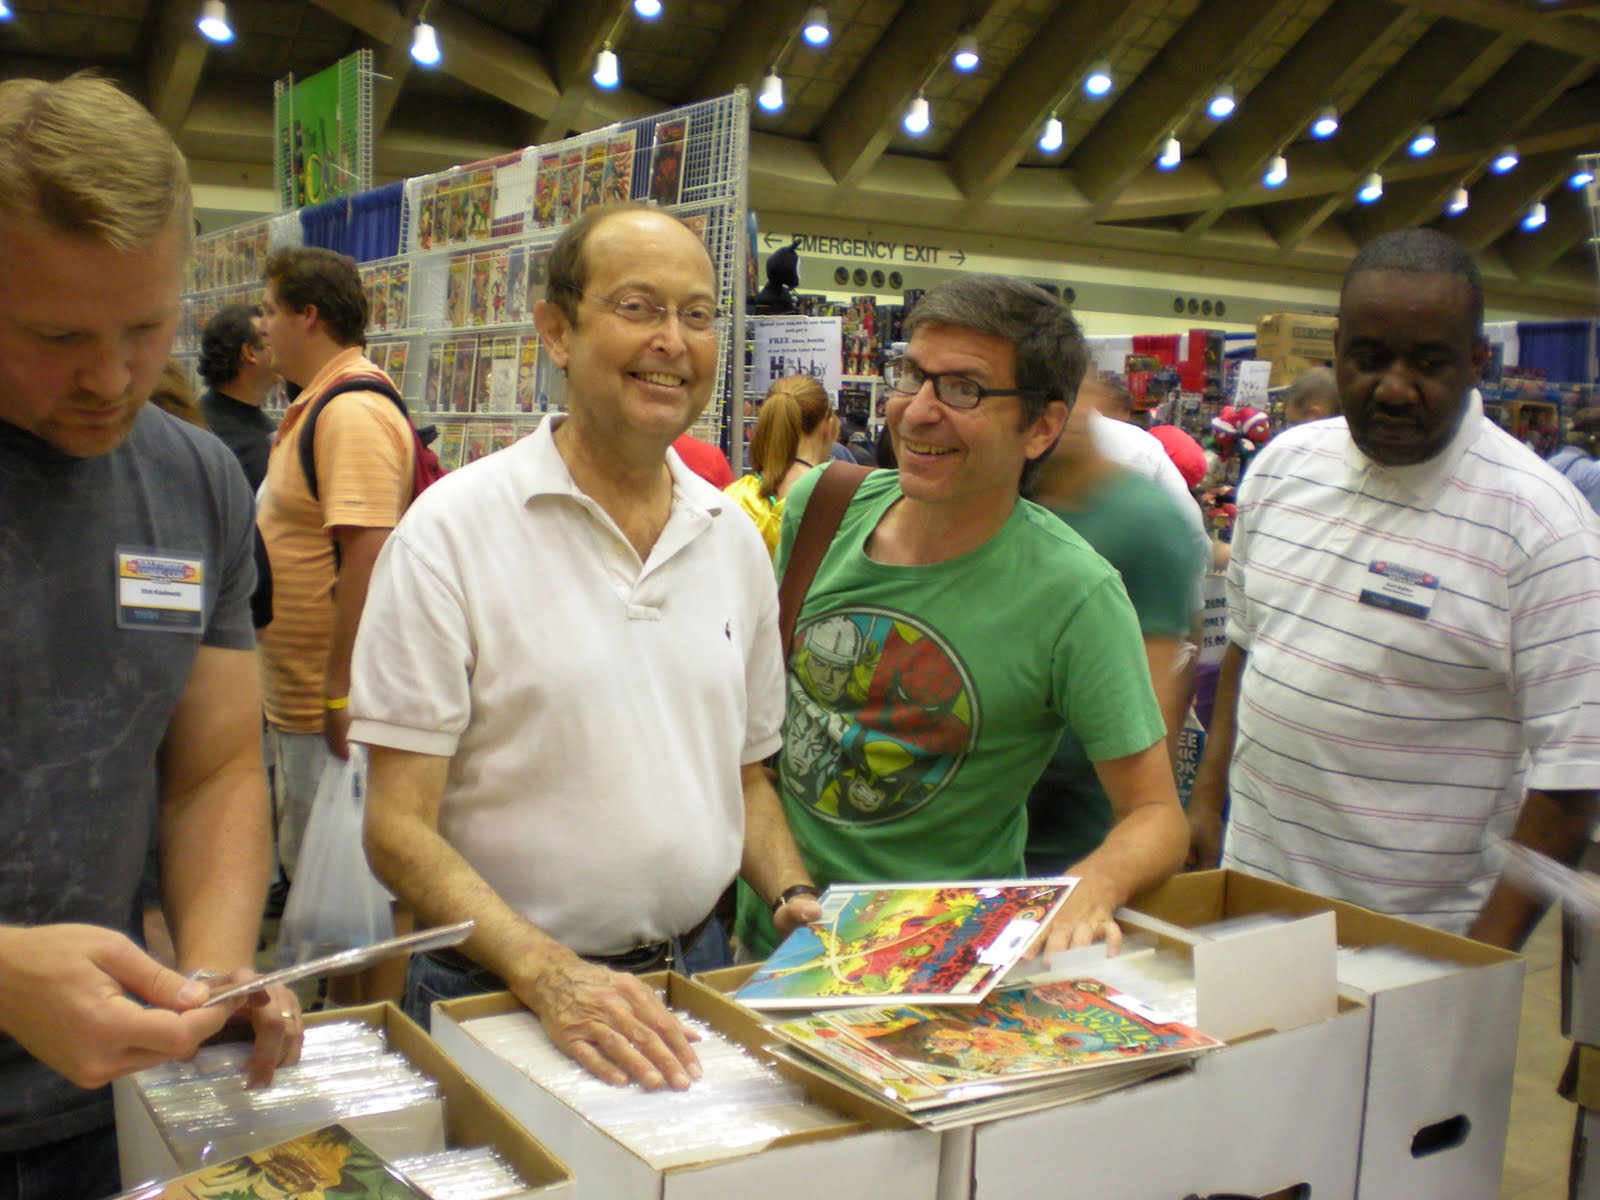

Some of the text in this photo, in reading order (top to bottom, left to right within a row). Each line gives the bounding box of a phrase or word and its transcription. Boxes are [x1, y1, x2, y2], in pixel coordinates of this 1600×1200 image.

[791, 233, 940, 263] EMERGENCY EXIT
[911, 896, 1007, 983] Bullseye
